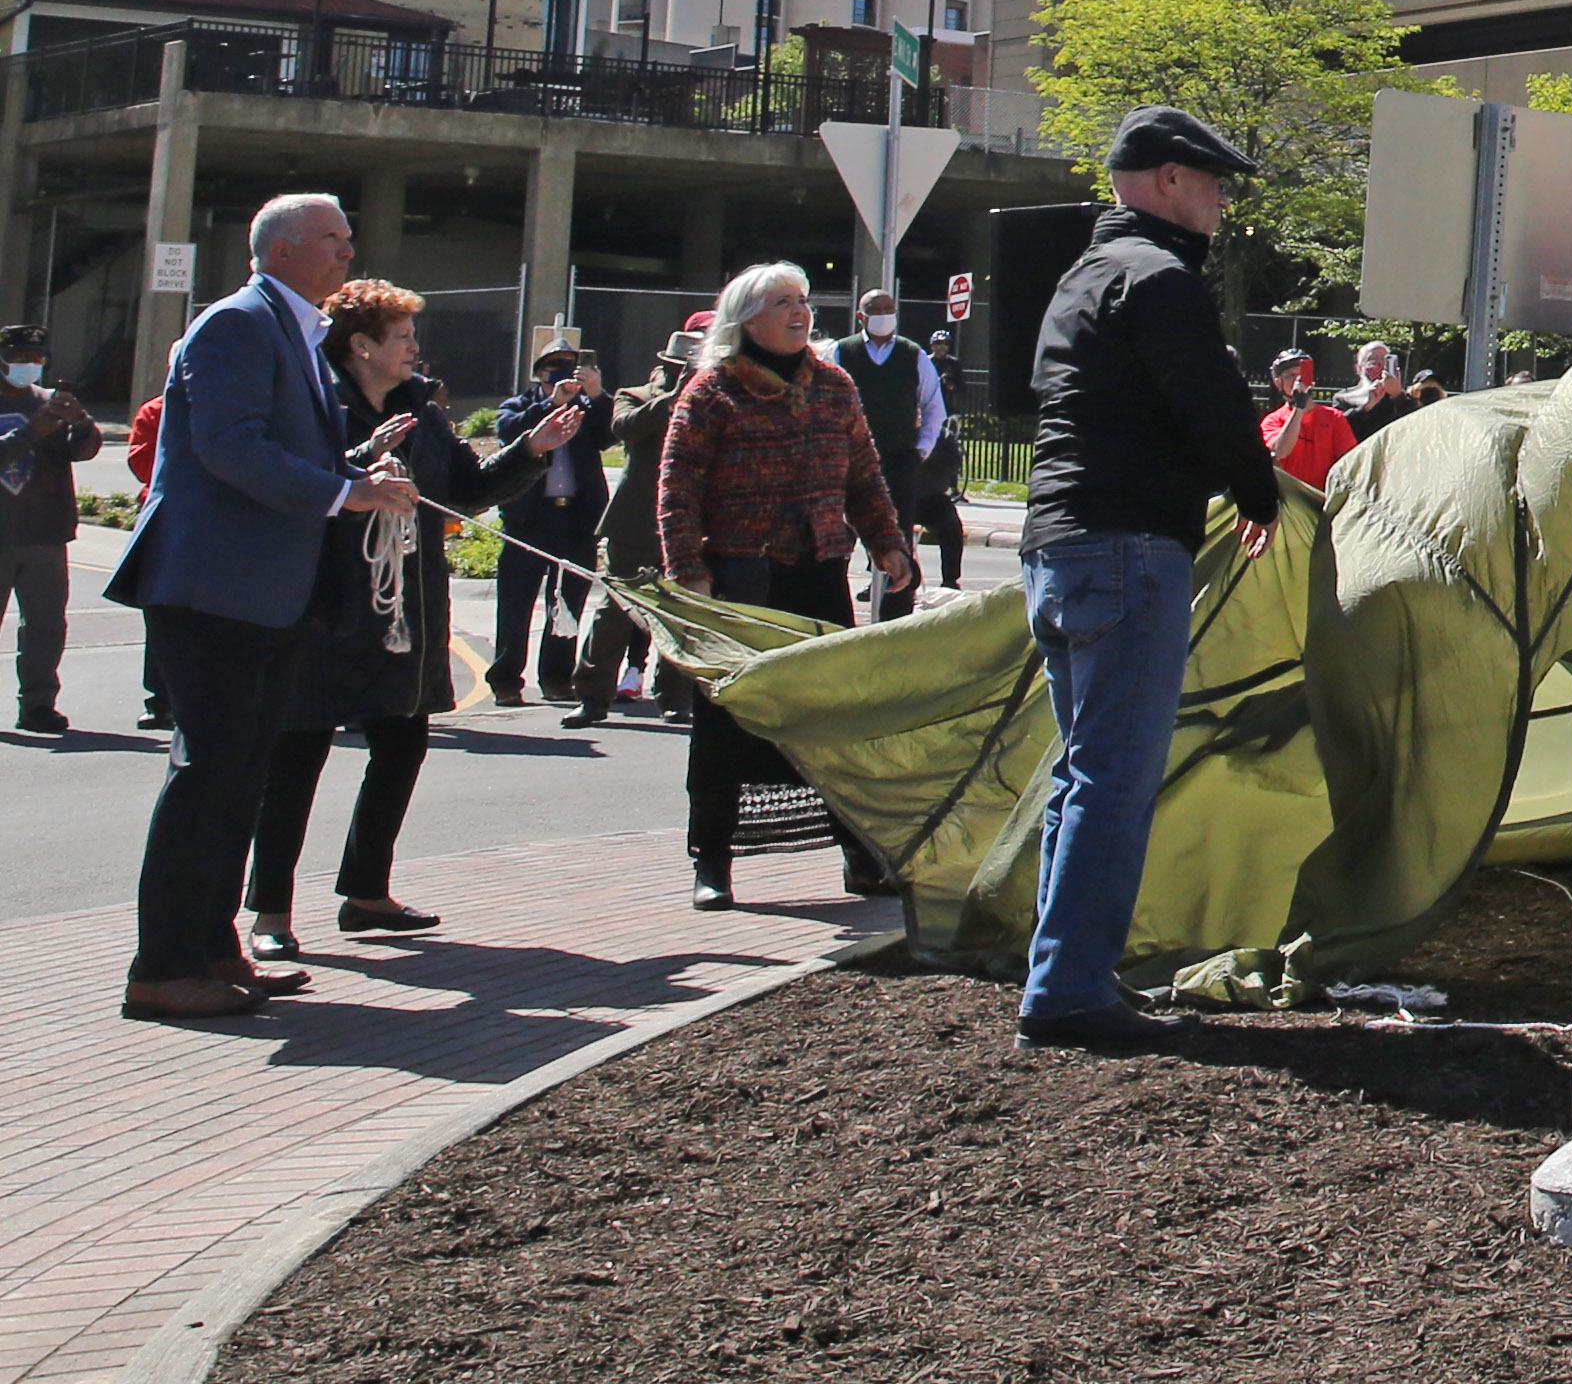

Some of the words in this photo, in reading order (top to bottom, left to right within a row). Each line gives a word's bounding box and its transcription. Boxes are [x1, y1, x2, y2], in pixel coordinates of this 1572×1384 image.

[168, 247, 181, 256] DO
[164, 258, 183, 266] NOT
[156, 268, 187, 277] BLOCK
[157, 278, 185, 289] DRIVE
